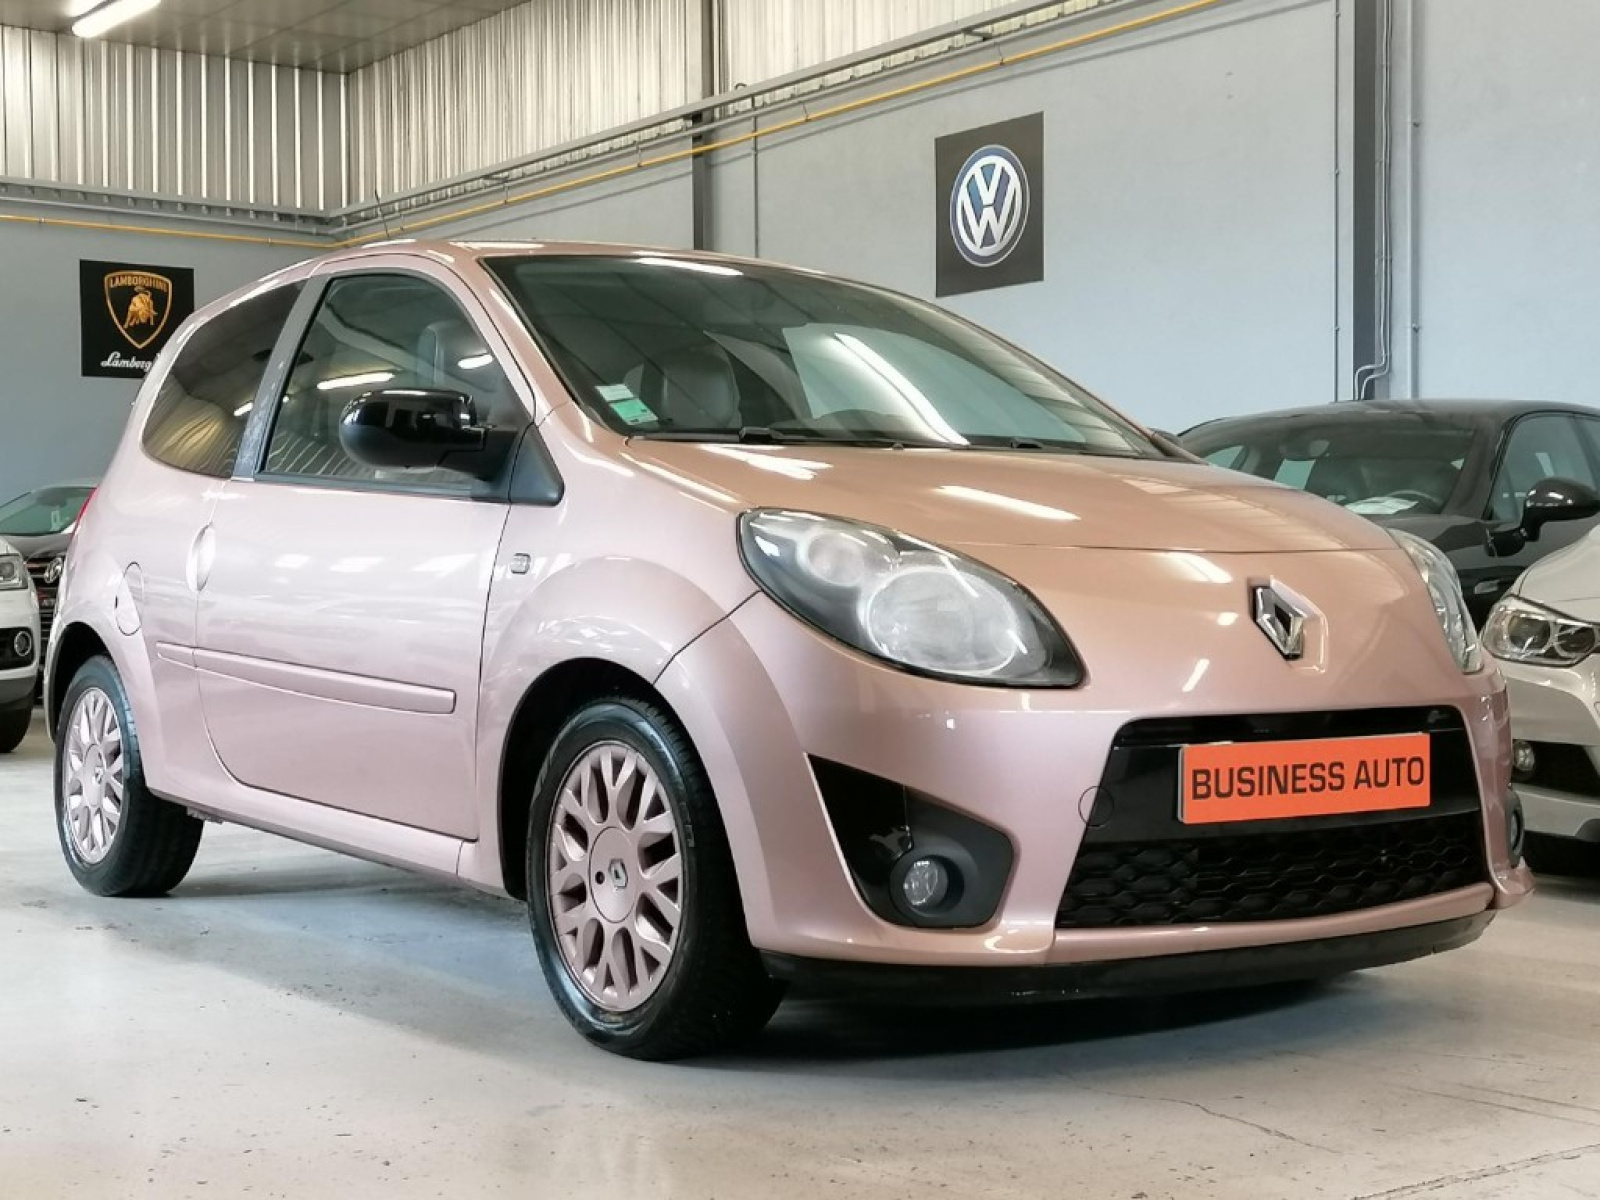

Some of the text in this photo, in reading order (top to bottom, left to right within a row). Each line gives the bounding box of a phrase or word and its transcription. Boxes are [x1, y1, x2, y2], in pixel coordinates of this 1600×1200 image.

[109, 275, 167, 292] LAMBORGHINI
[100, 351, 157, 373] Lamborg
[1192, 756, 1424, 800] BUSINESS AUTO
